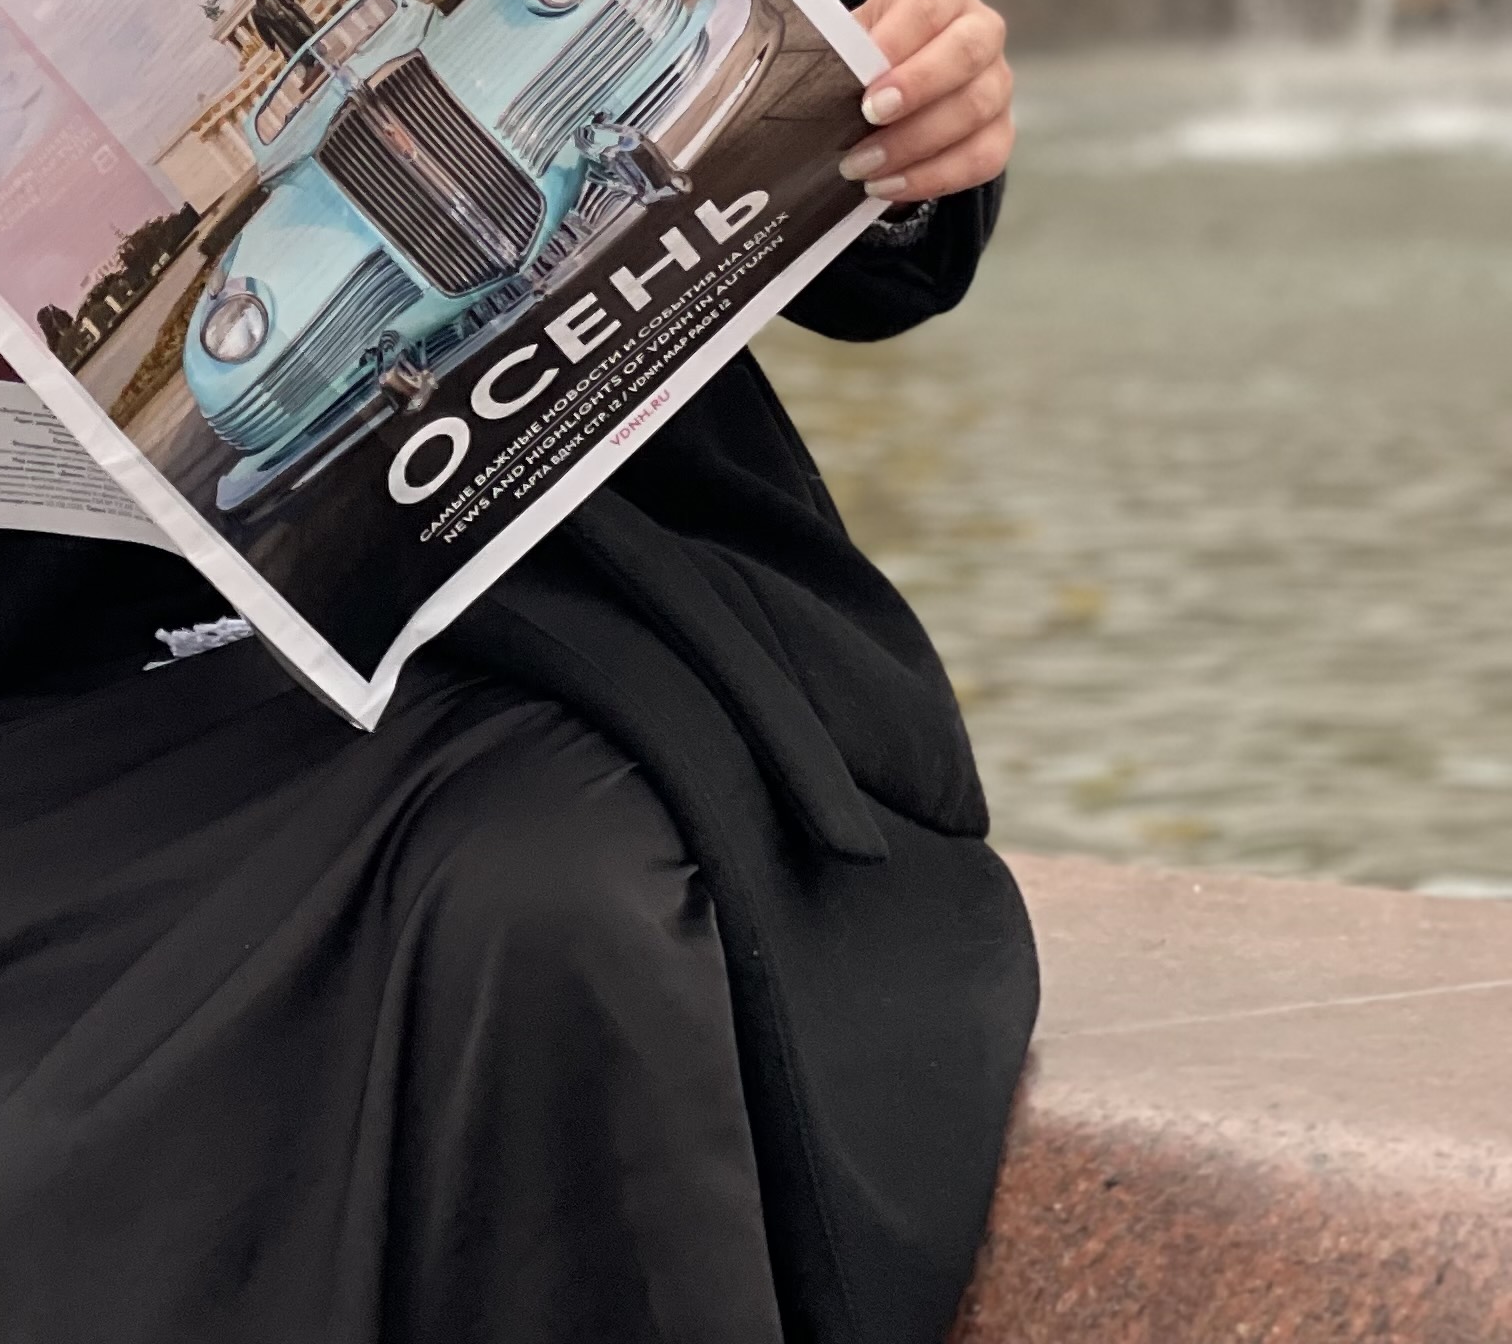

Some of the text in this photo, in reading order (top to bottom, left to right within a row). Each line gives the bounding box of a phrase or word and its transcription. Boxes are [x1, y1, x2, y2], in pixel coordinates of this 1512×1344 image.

[388, 190, 770, 504] ОСЕНЬ
[420, 212, 788, 542] САМЫЕ ВАЖНЫЕ НОВОСТИ И СОБЫТИЯ НА ВДНХ
[444, 236, 783, 543] NEWS AND HIGHLIGHTS OF VDNH IN AUTUMN
[514, 465, 552, 498] КАРТА
[551, 434, 584, 464] ВДНХ
[608, 400, 622, 412] 12
[628, 360, 663, 392] VDNH
[664, 337, 687, 362] MAP
[688, 310, 719, 338] PAGE
[719, 299, 731, 310] 12
[609, 390, 672, 447] VDNH.RU
